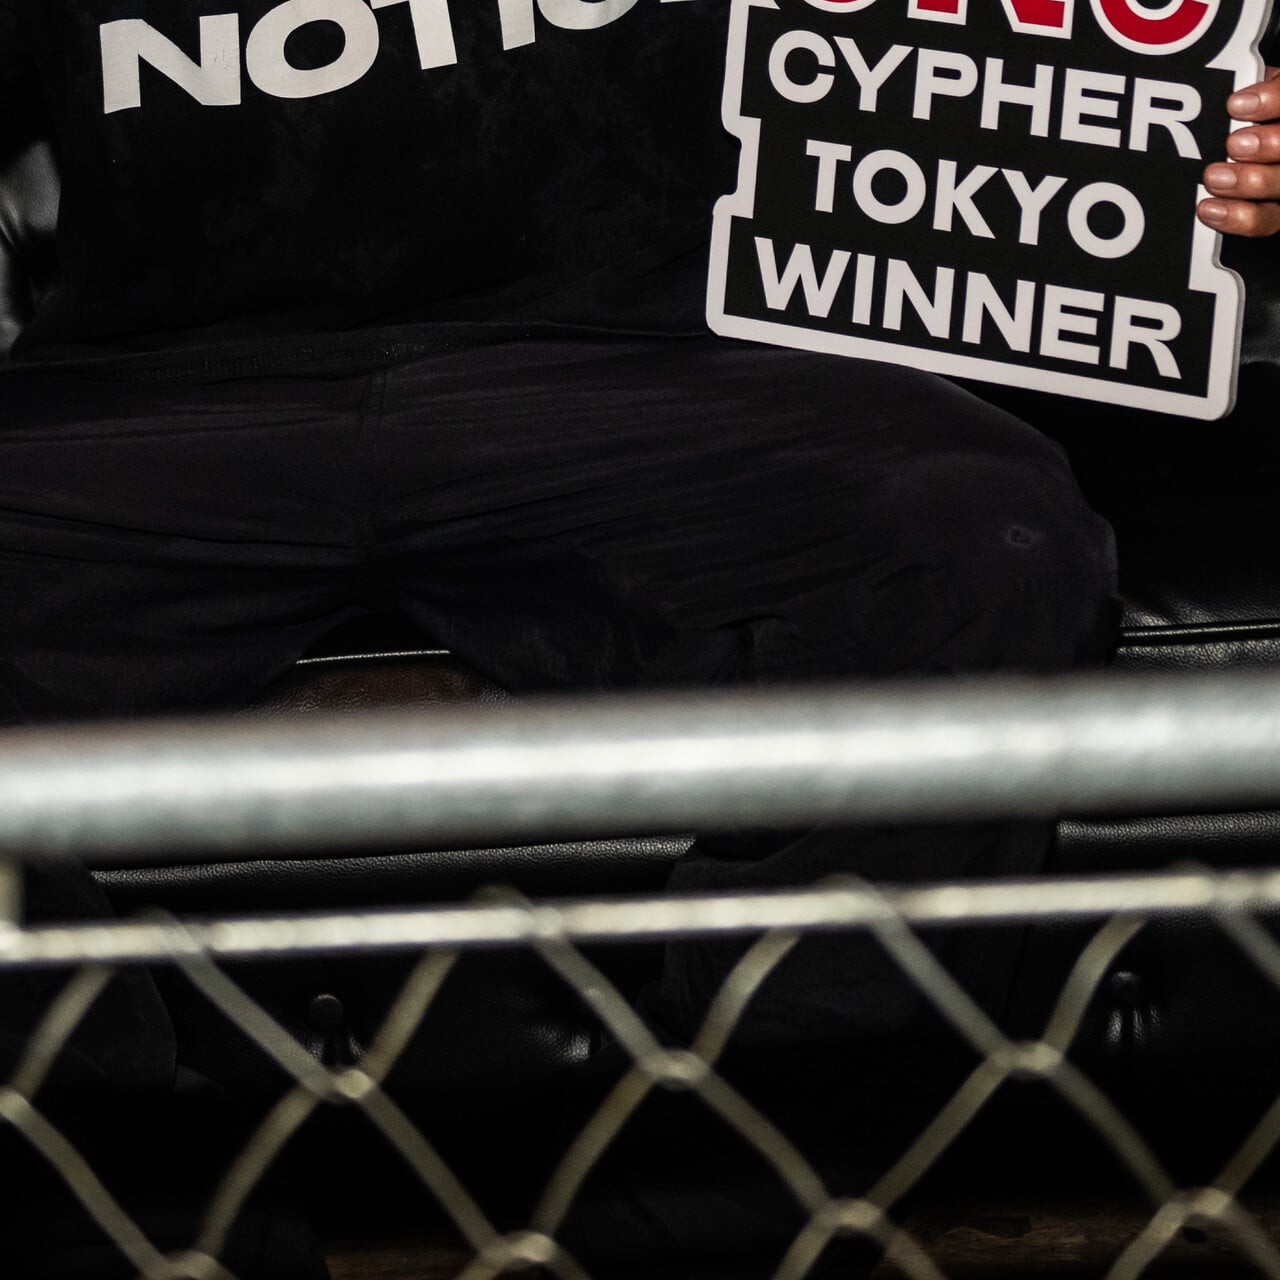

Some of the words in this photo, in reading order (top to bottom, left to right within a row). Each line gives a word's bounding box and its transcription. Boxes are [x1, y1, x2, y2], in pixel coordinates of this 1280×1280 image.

[767, 29, 1204, 161] CYPHER
[805, 138, 1146, 260] TOKYO
[753, 236, 1183, 380] WINNER
